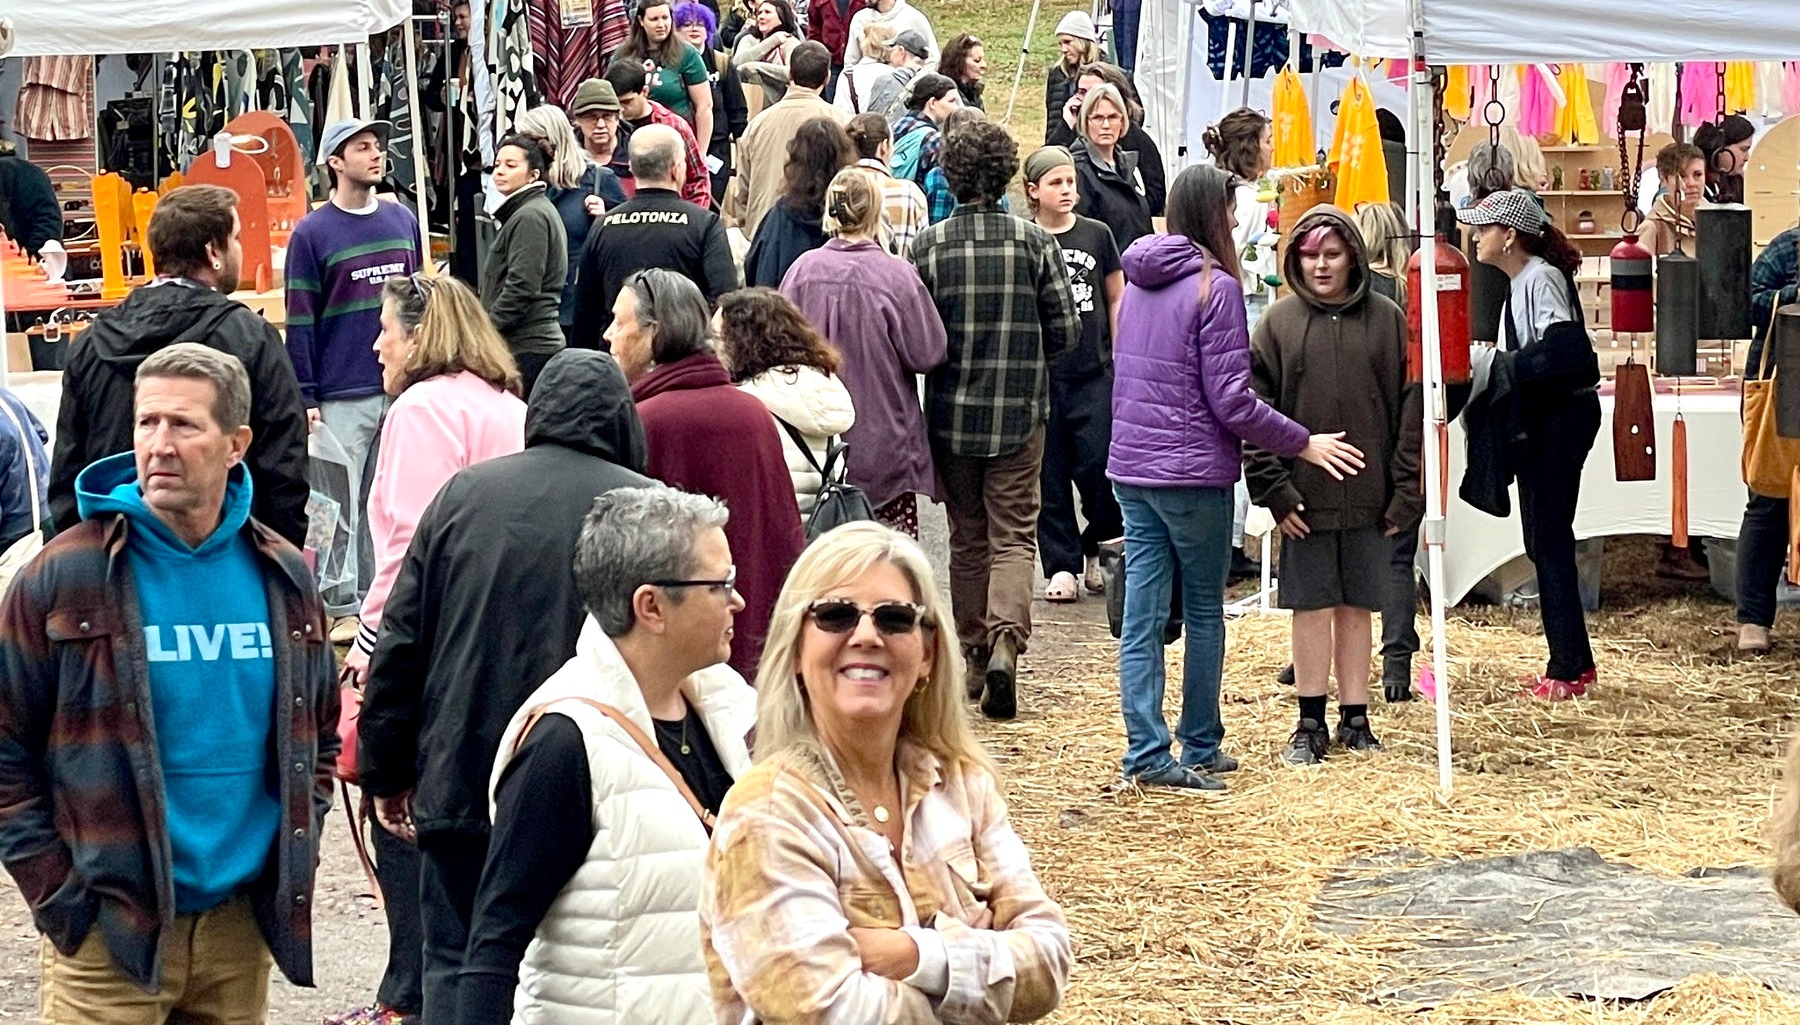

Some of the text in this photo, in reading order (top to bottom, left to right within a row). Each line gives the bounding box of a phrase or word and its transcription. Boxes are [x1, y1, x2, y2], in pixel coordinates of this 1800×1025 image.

[603, 211, 688, 226] PELOTONIA
[1061, 249, 1097, 271] ENS
[351, 262, 405, 281] SUPREM
[143, 622, 273, 662] LIVE!
